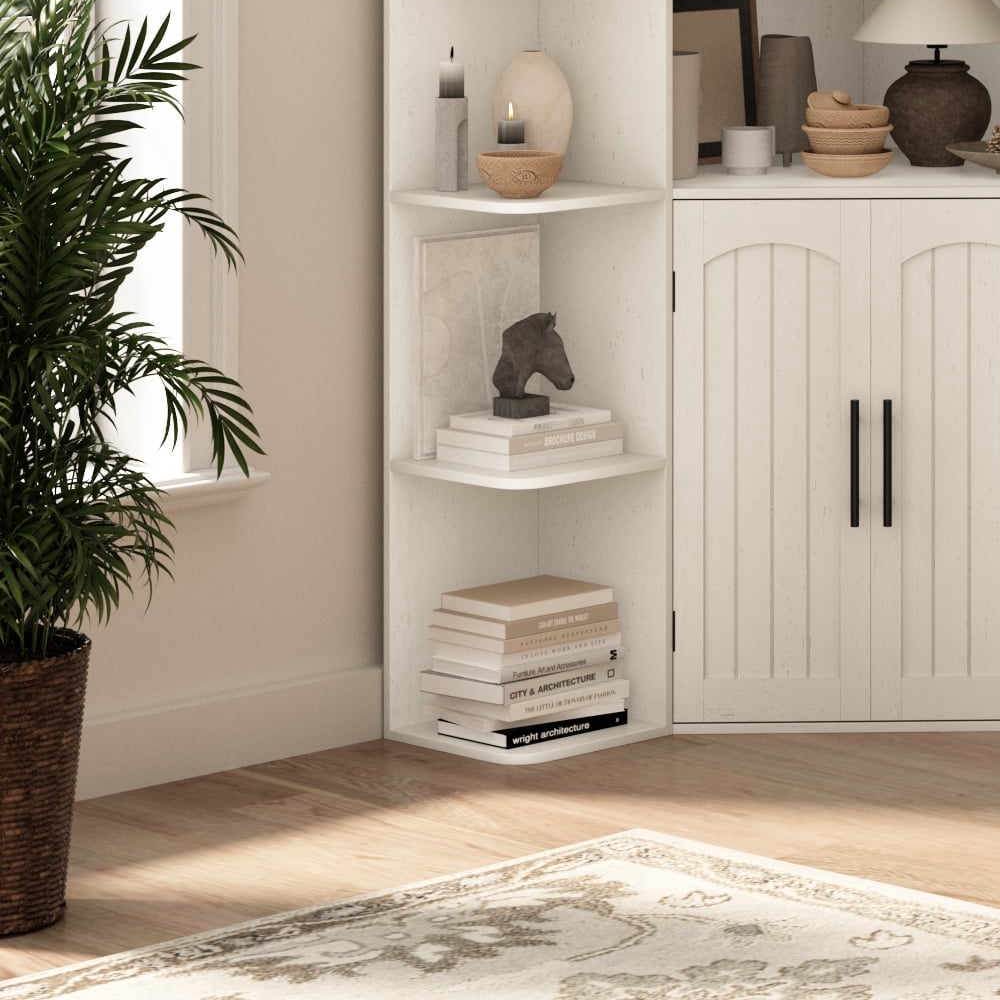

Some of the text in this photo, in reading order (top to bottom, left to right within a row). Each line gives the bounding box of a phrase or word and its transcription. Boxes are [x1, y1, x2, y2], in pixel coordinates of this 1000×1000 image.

[544, 432, 575, 447] BROCHURE
[575, 429, 597, 442] DESIGN
[509, 673, 596, 700] CITY & ARCHITECTURE
[512, 722, 590, 746] wright architecture
